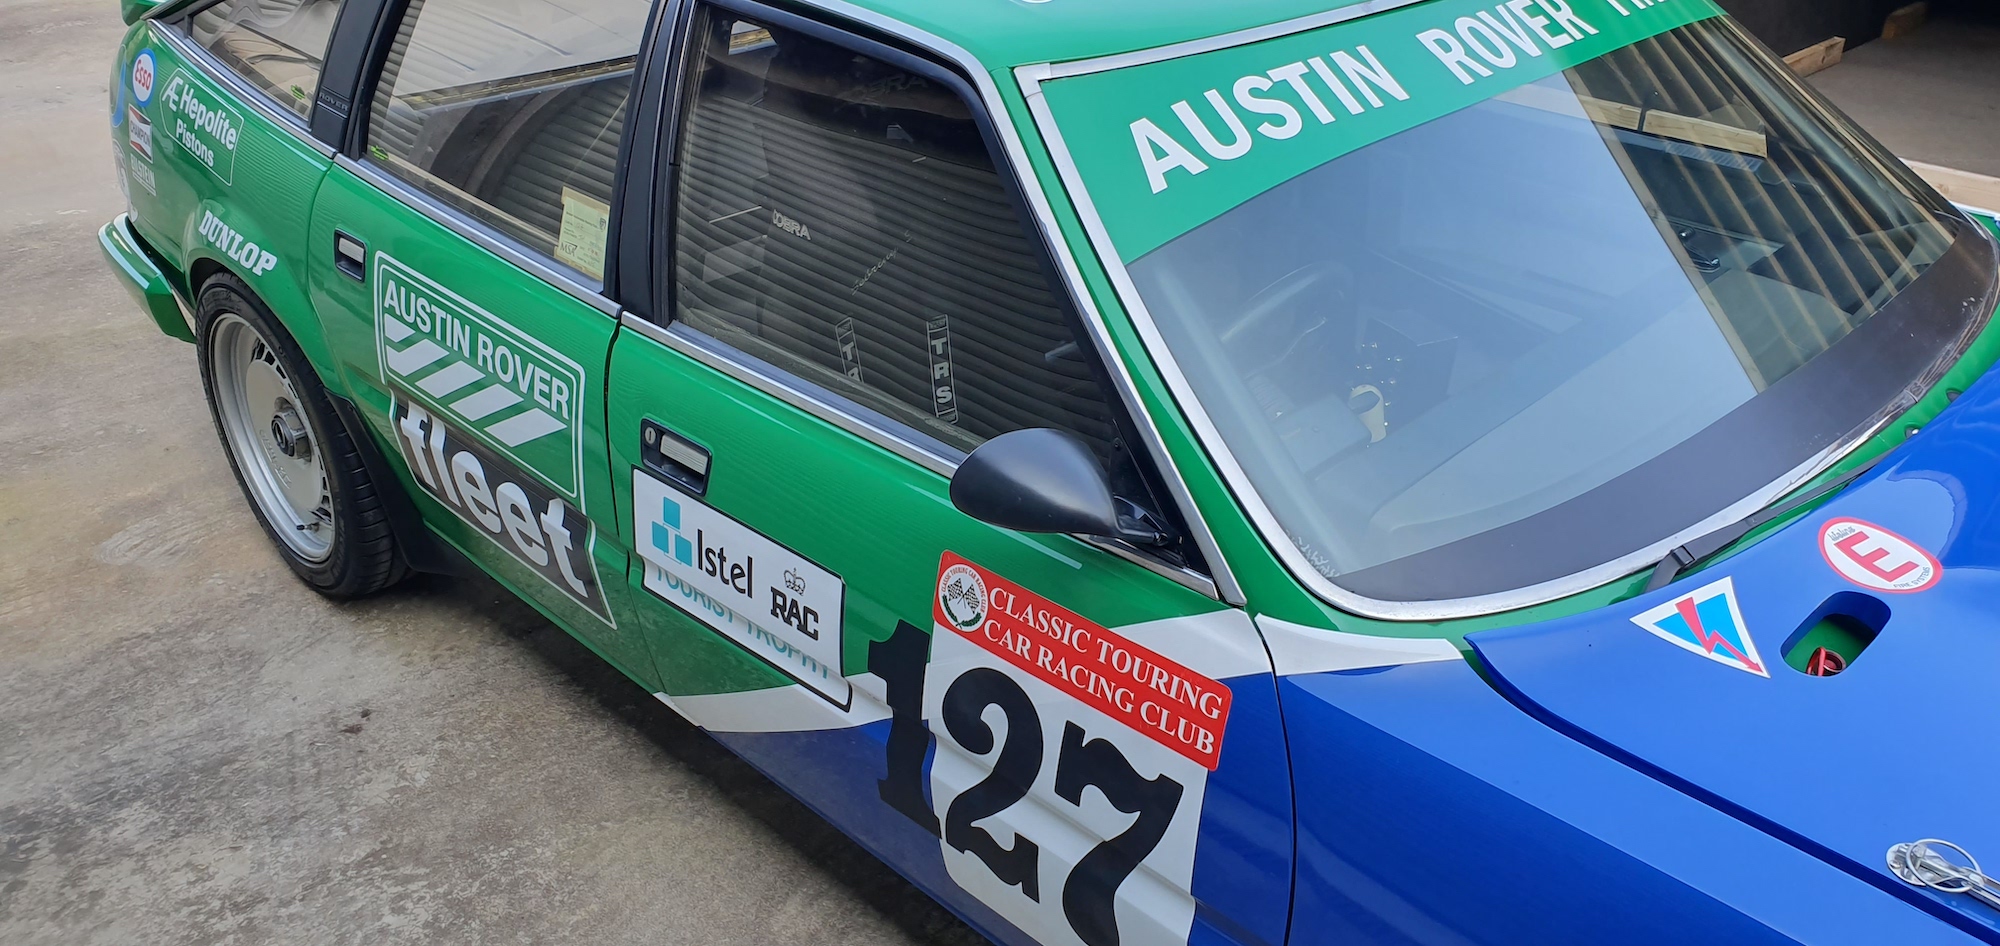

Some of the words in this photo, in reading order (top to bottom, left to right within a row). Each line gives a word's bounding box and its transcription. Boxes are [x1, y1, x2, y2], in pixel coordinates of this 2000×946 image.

[180, 84, 236, 150] Hepolite
[1128, 45, 1410, 194] AUSTIN
[1415, 0, 1599, 85] ROVER
[176, 118, 214, 167] Pistons
[198, 209, 278, 276] DUNLOP
[384, 280, 470, 358] AUSTIN
[478, 333, 569, 419] ROVER
[931, 337, 952, 403] TRS
[400, 399, 588, 598] fleet
[697, 529, 753, 599] Istel
[1834, 531, 1919, 582] E
[770, 586, 819, 641] RAC
[984, 620, 1031, 662] CAR
[1036, 644, 1134, 713] RACING
[1140, 701, 1214, 755] CLUB
[989, 587, 1091, 653] CLASSIC
[1097, 639, 1222, 720] TOURING
[868, 619, 1184, 946] 127
